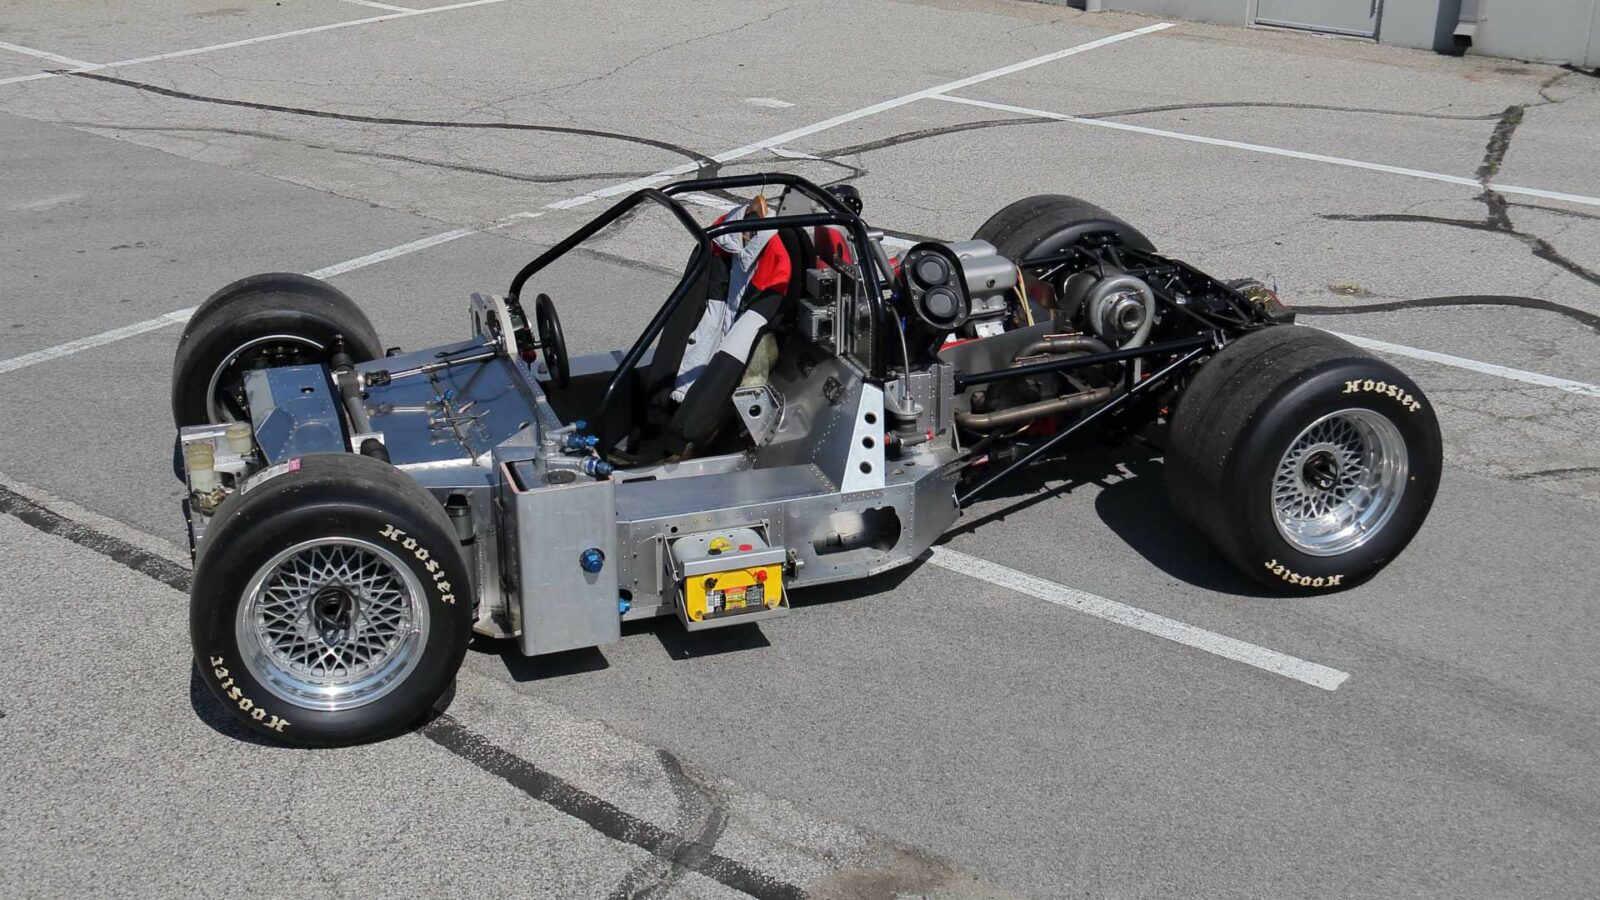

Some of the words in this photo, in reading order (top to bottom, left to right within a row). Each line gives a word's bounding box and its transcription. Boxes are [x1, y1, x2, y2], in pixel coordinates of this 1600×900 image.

[1342, 379, 1421, 412] Hoosier
[378, 524, 456, 605] Hoosier
[1264, 559, 1345, 588] Hoosier
[209, 655, 291, 733] Hoosier
